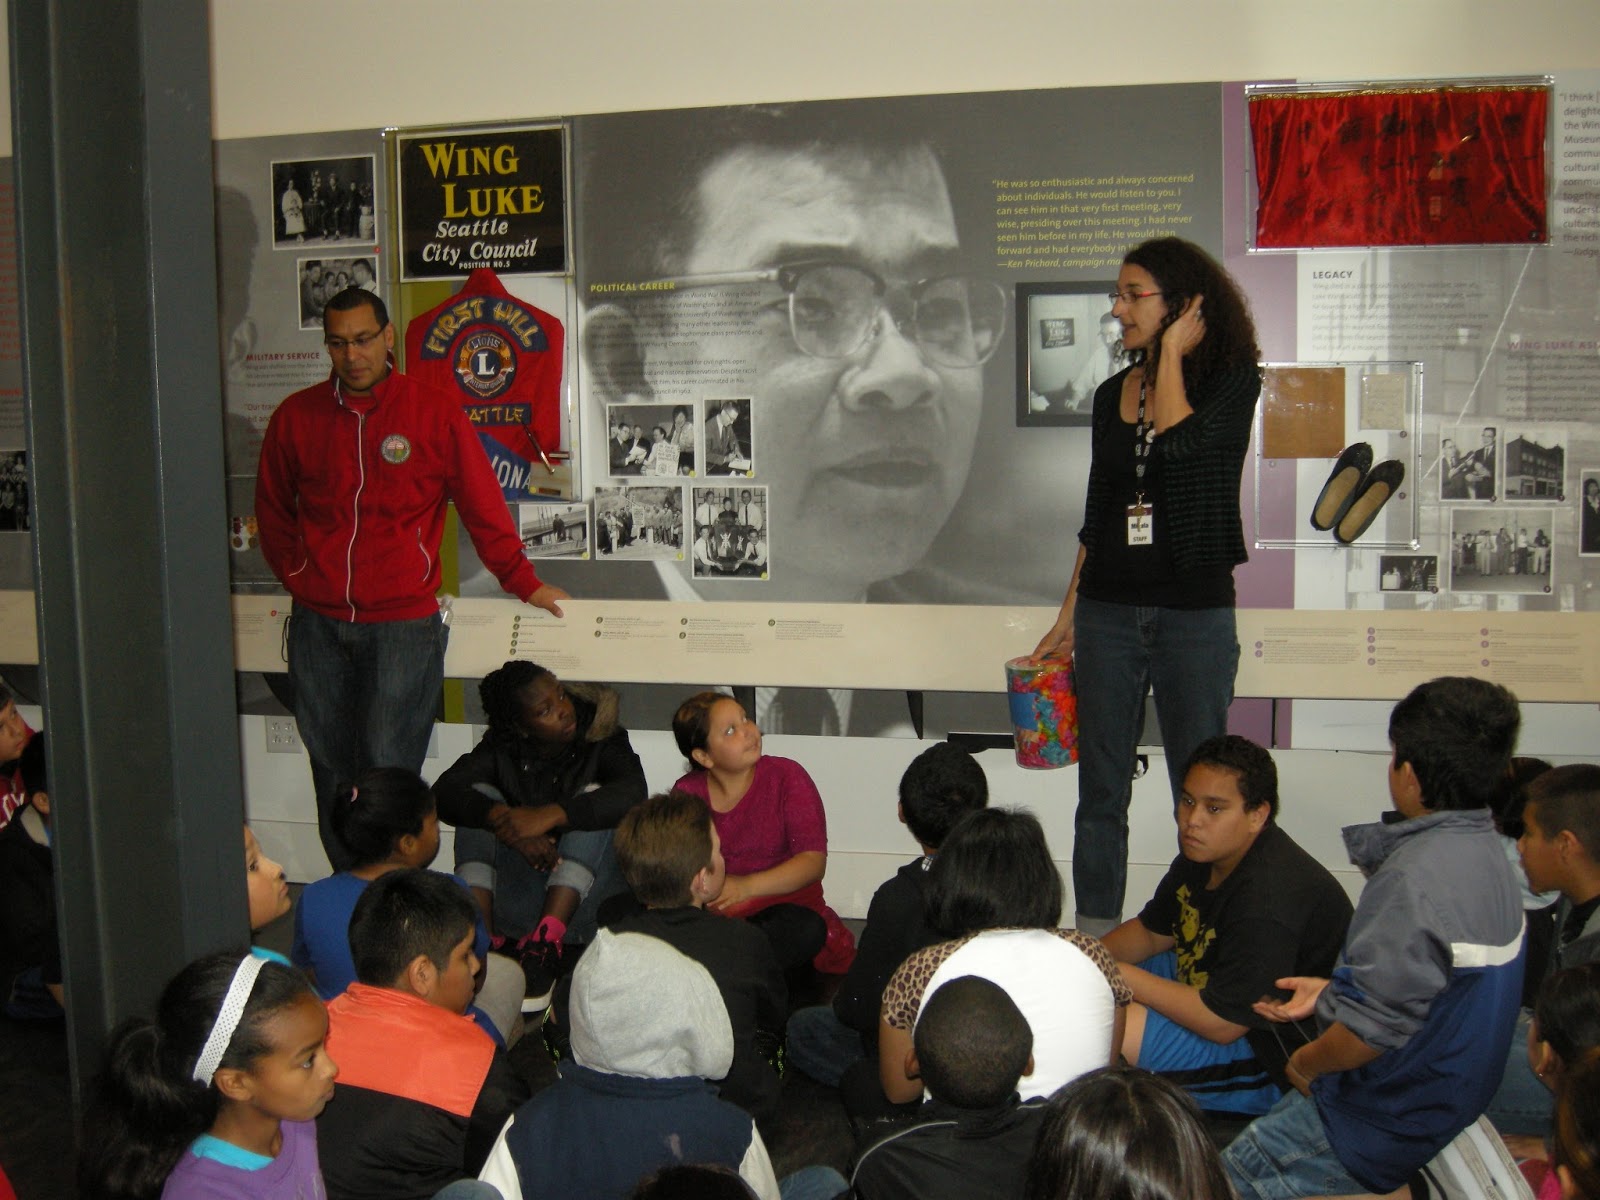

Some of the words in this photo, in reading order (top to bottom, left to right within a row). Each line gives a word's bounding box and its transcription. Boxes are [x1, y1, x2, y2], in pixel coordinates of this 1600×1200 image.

[1569, 93, 1593, 101] think
[419, 142, 520, 178] WING
[1563, 163, 1599, 172] cultural
[992, 180, 1008, 188] “He
[1042, 178, 1094, 186] enthusiastic
[1116, 176, 1145, 186] always
[1148, 174, 1194, 183] concerned
[442, 184, 544, 218] LUKE
[997, 193, 1022, 202] about
[1024, 192, 1074, 200] individuals.
[1090, 190, 1117, 198] would
[1158, 190, 1176, 199] you.
[1178, 188, 1181, 196] I
[1061, 205, 1078, 213] that
[1081, 206, 1100, 214] very
[1102, 203, 1119, 212] first
[1122, 203, 1161, 212] meeting,
[1163, 203, 1182, 212] very
[1563, 206, 1600, 214] underst
[436, 218, 508, 238] Seattle
[997, 221, 1019, 229] wise,
[1021, 219, 1061, 229] presiding
[1084, 217, 1101, 226] this
[1020, 233, 1036, 241] him
[1038, 232, 1066, 240] before
[1080, 232, 1093, 241] my
[1095, 230, 1110, 239] life.
[1113, 230, 1124, 238] He
[1127, 229, 1154, 238] would
[1157, 229, 1175, 237] lean
[422, 243, 460, 266] City
[470, 238, 538, 260] Council
[997, 246, 1031, 255] forward
[1034, 246, 1049, 254] and
[1052, 245, 1068, 253] had
[1071, 242, 1115, 255] everybody
[1129, 243, 1141, 251] lin
[459, 261, 490, 269] POSITION
[1025, 259, 1061, 267] Prichard,
[1063, 258, 1104, 268] campaign
[1313, 271, 1353, 279] LEGACY
[590, 284, 636, 292] POLITICAL
[639, 282, 676, 290] CAREER
[426, 298, 485, 354] FIRST
[493, 302, 539, 348] HILL
[472, 337, 500, 349] LIONS
[246, 353, 284, 361] MILITARY
[477, 353, 495, 375] L
[464, 408, 524, 423] ATTLE
